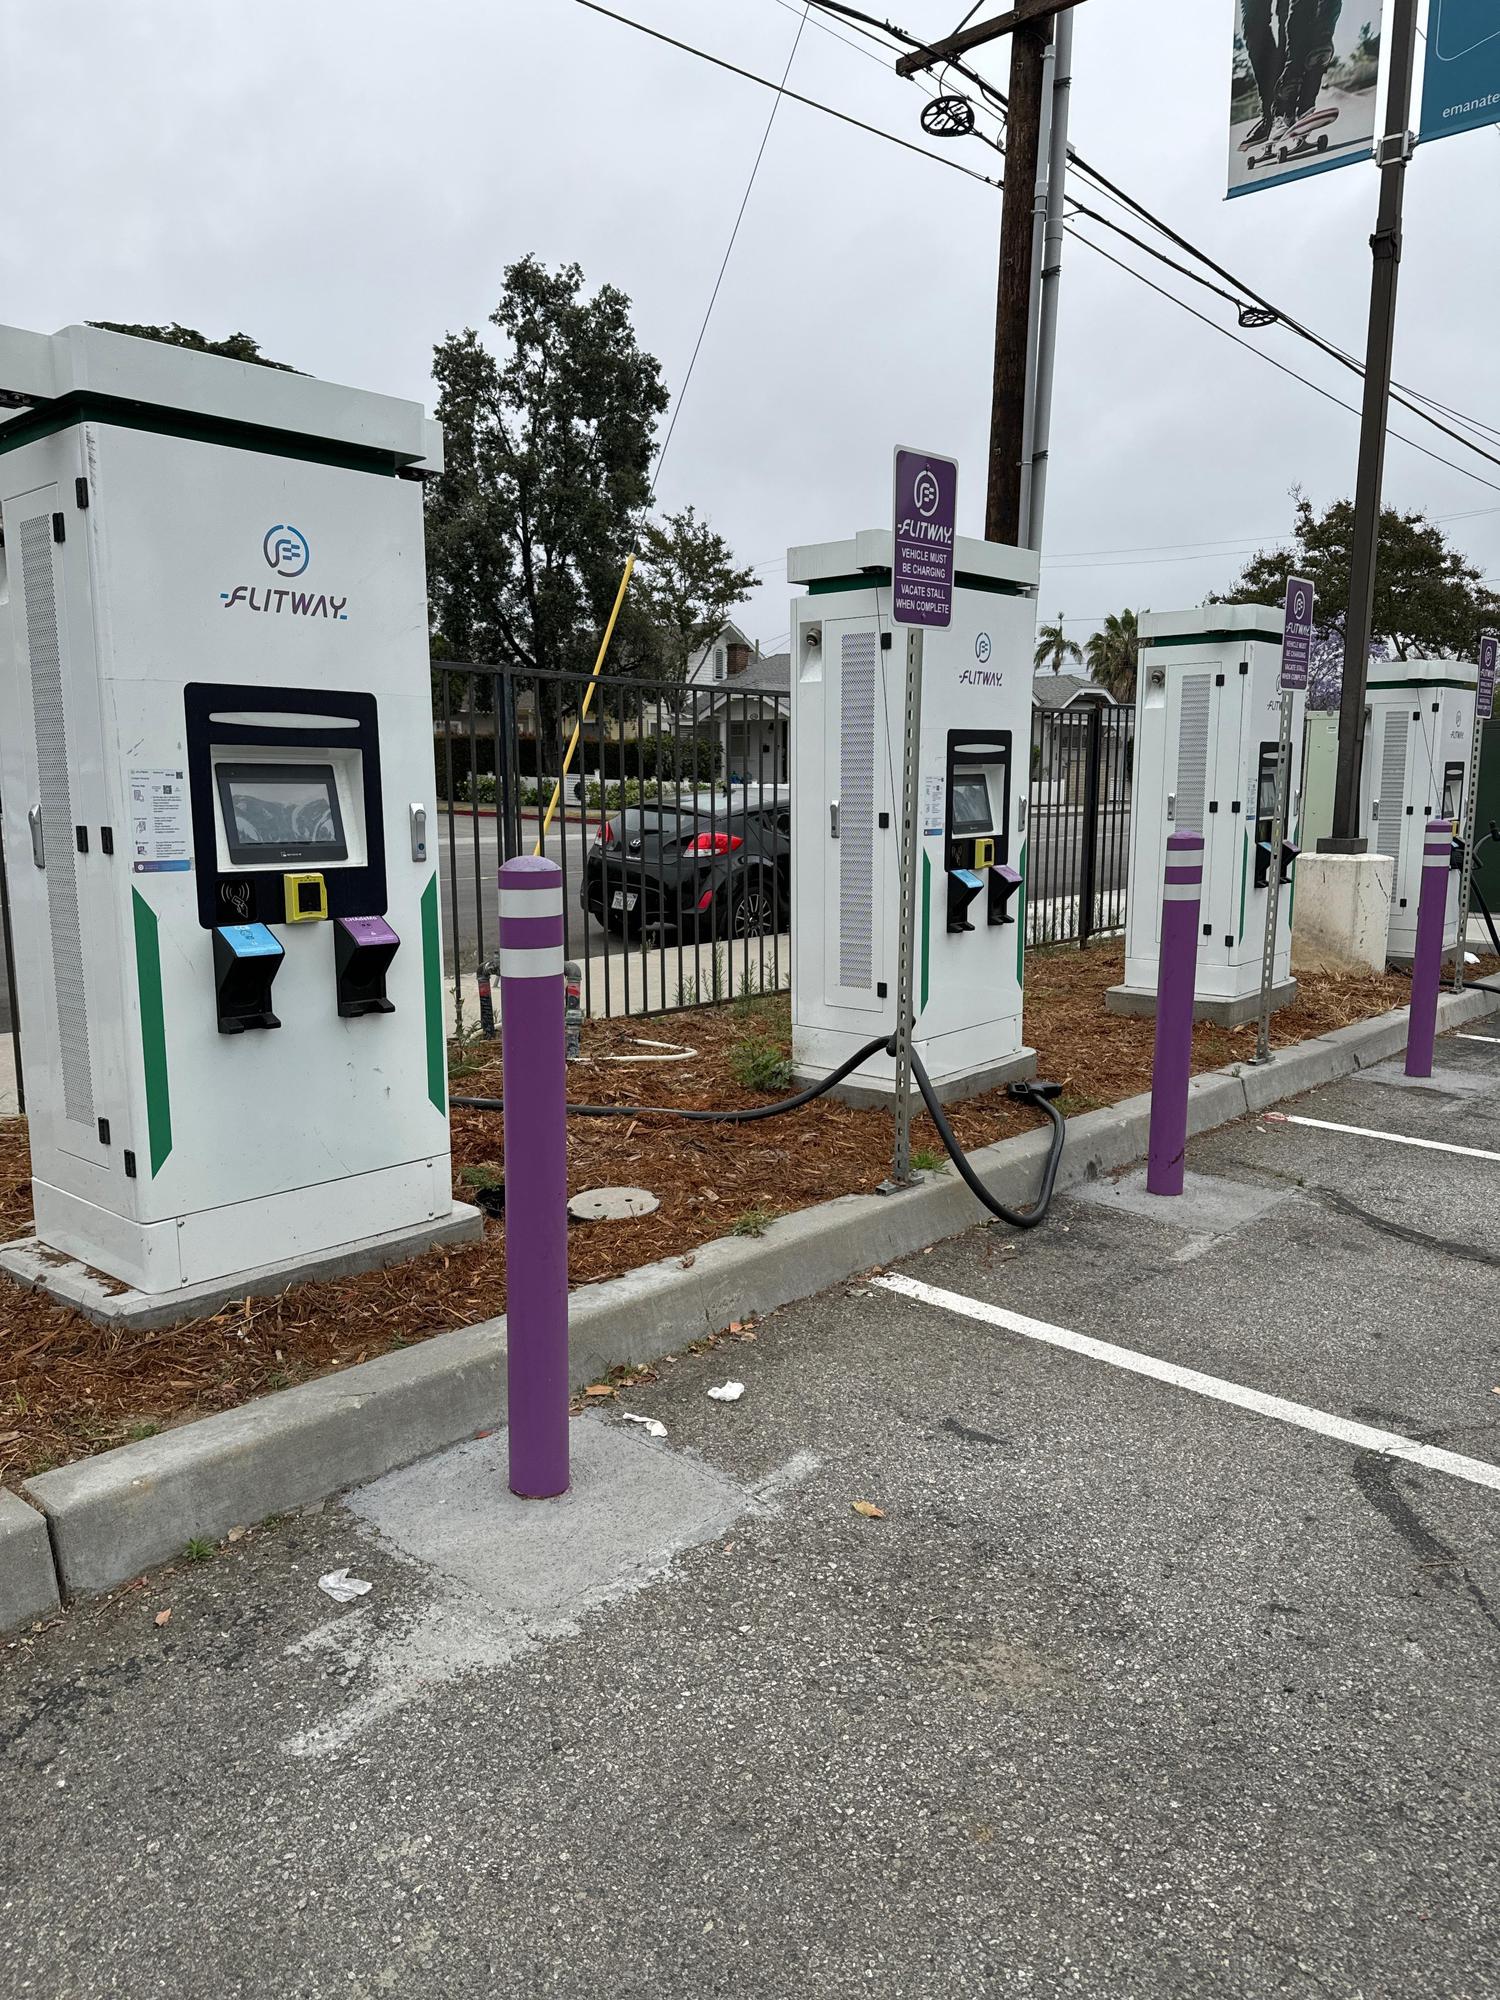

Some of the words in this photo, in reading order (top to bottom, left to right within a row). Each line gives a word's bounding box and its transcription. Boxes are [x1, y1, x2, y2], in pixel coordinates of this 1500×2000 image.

[1442, 93, 1500, 118] emanate
[898, 519, 952, 544] FLITWAY
[901, 547, 929, 561] VEHICLE
[930, 552, 947, 564] MUST
[902, 562, 911, 573] BE
[912, 564, 946, 579] CHARGING
[901, 583, 926, 597] VACATE
[926, 587, 946, 600] STALL
[223, 585, 348, 619] FLITWAY
[895, 598, 915, 610] WHEN
[916, 601, 950, 614] COMPLETE
[960, 670, 1002, 686] FLITWAY
